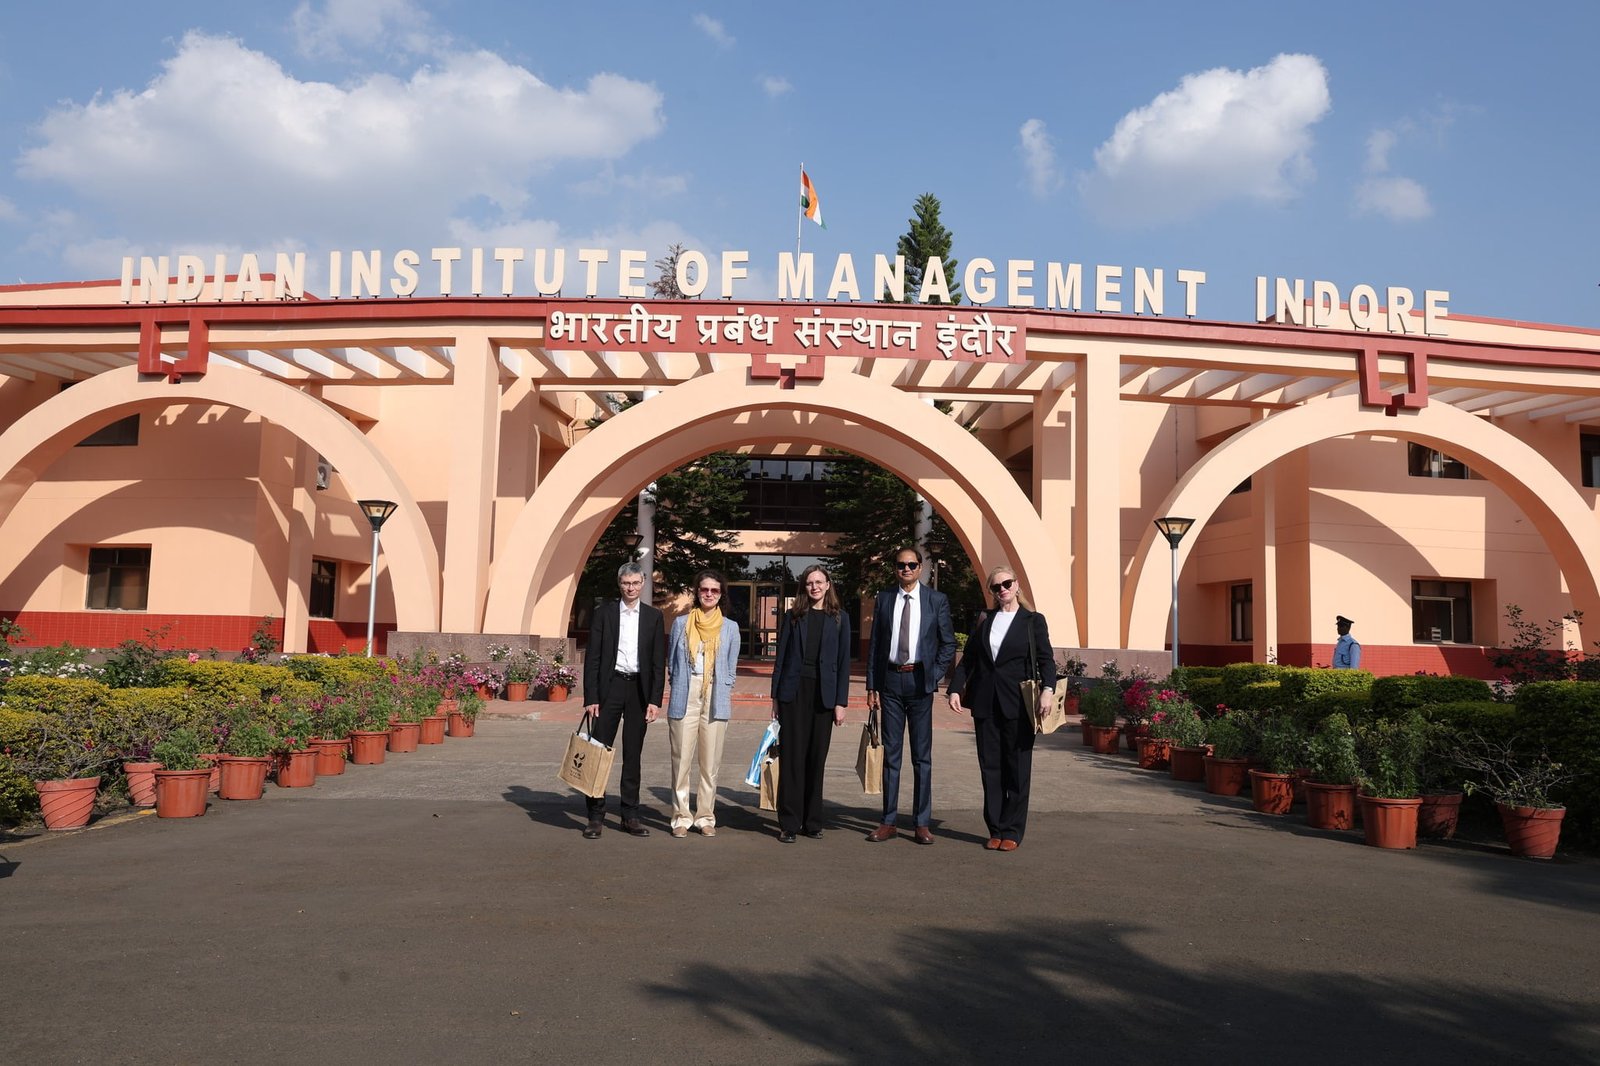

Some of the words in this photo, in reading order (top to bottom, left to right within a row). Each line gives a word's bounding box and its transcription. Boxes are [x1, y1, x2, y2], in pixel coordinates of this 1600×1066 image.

[121, 252, 306, 303] INDIAN
[330, 247, 647, 298] INSTITUTE
[676, 250, 749, 298] OF
[778, 252, 1207, 317] MANAGEMENT
[1256, 276, 1450, 335] INDORE
[550, 303, 682, 344] भारतीय
[696, 307, 779, 345] प्रबंध
[794, 309, 922, 350] संस्थान
[936, 313, 1018, 359] इंदौर
